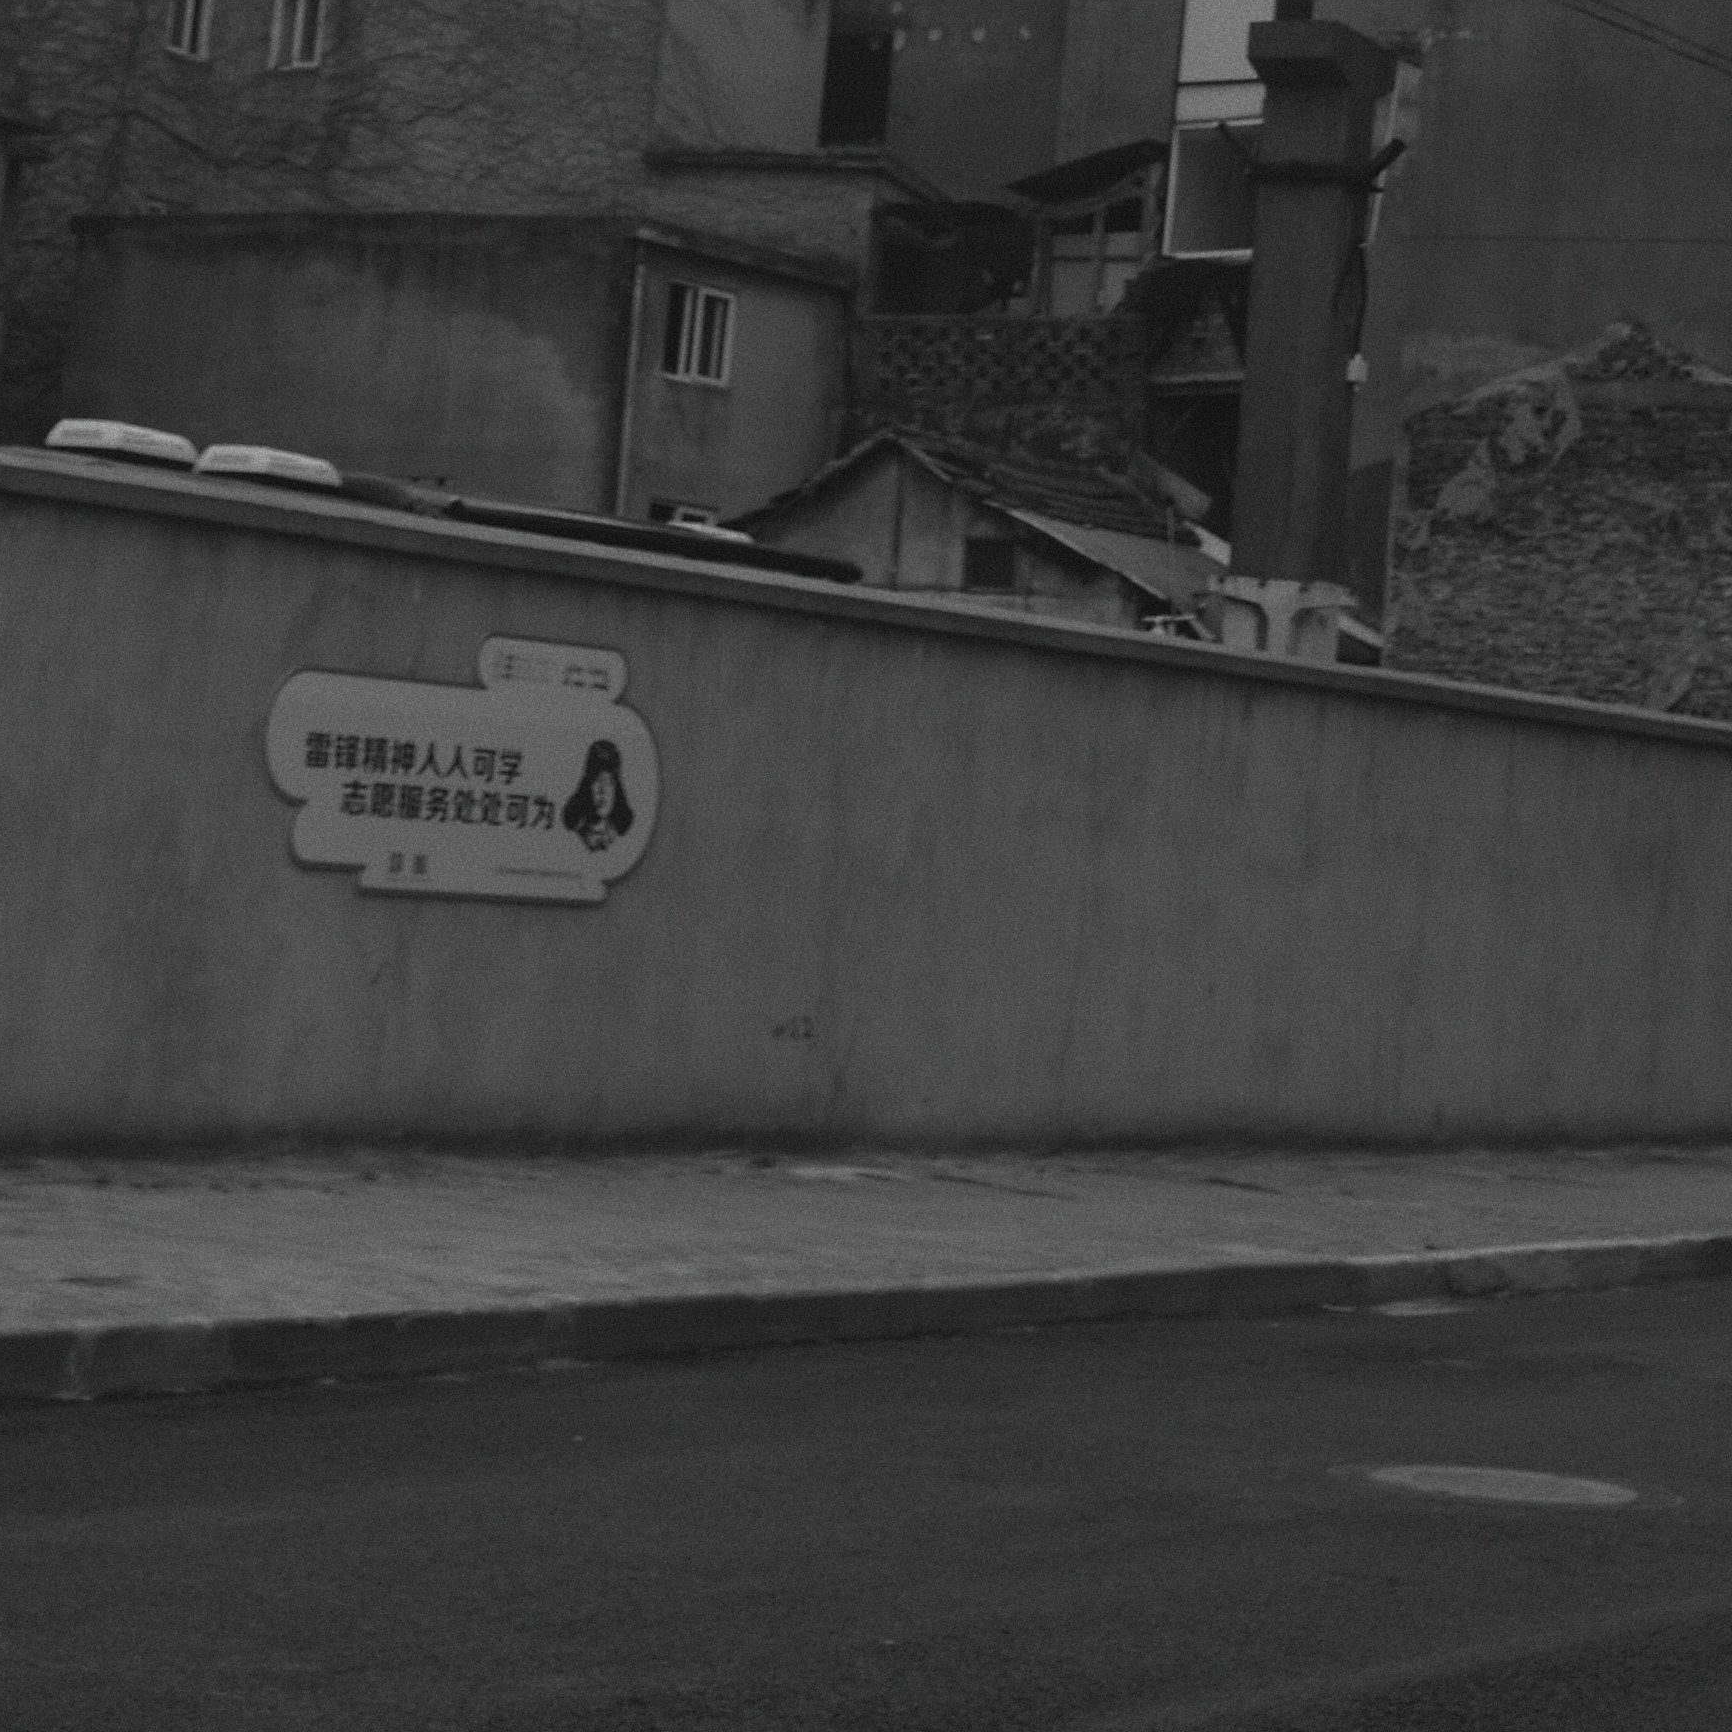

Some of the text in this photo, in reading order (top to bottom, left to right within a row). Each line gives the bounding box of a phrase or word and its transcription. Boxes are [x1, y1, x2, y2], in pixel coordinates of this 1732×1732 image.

[305, 731, 523, 785] 雷锋精神人人可学
[340, 779, 556, 831] 志愿服务处处可为
